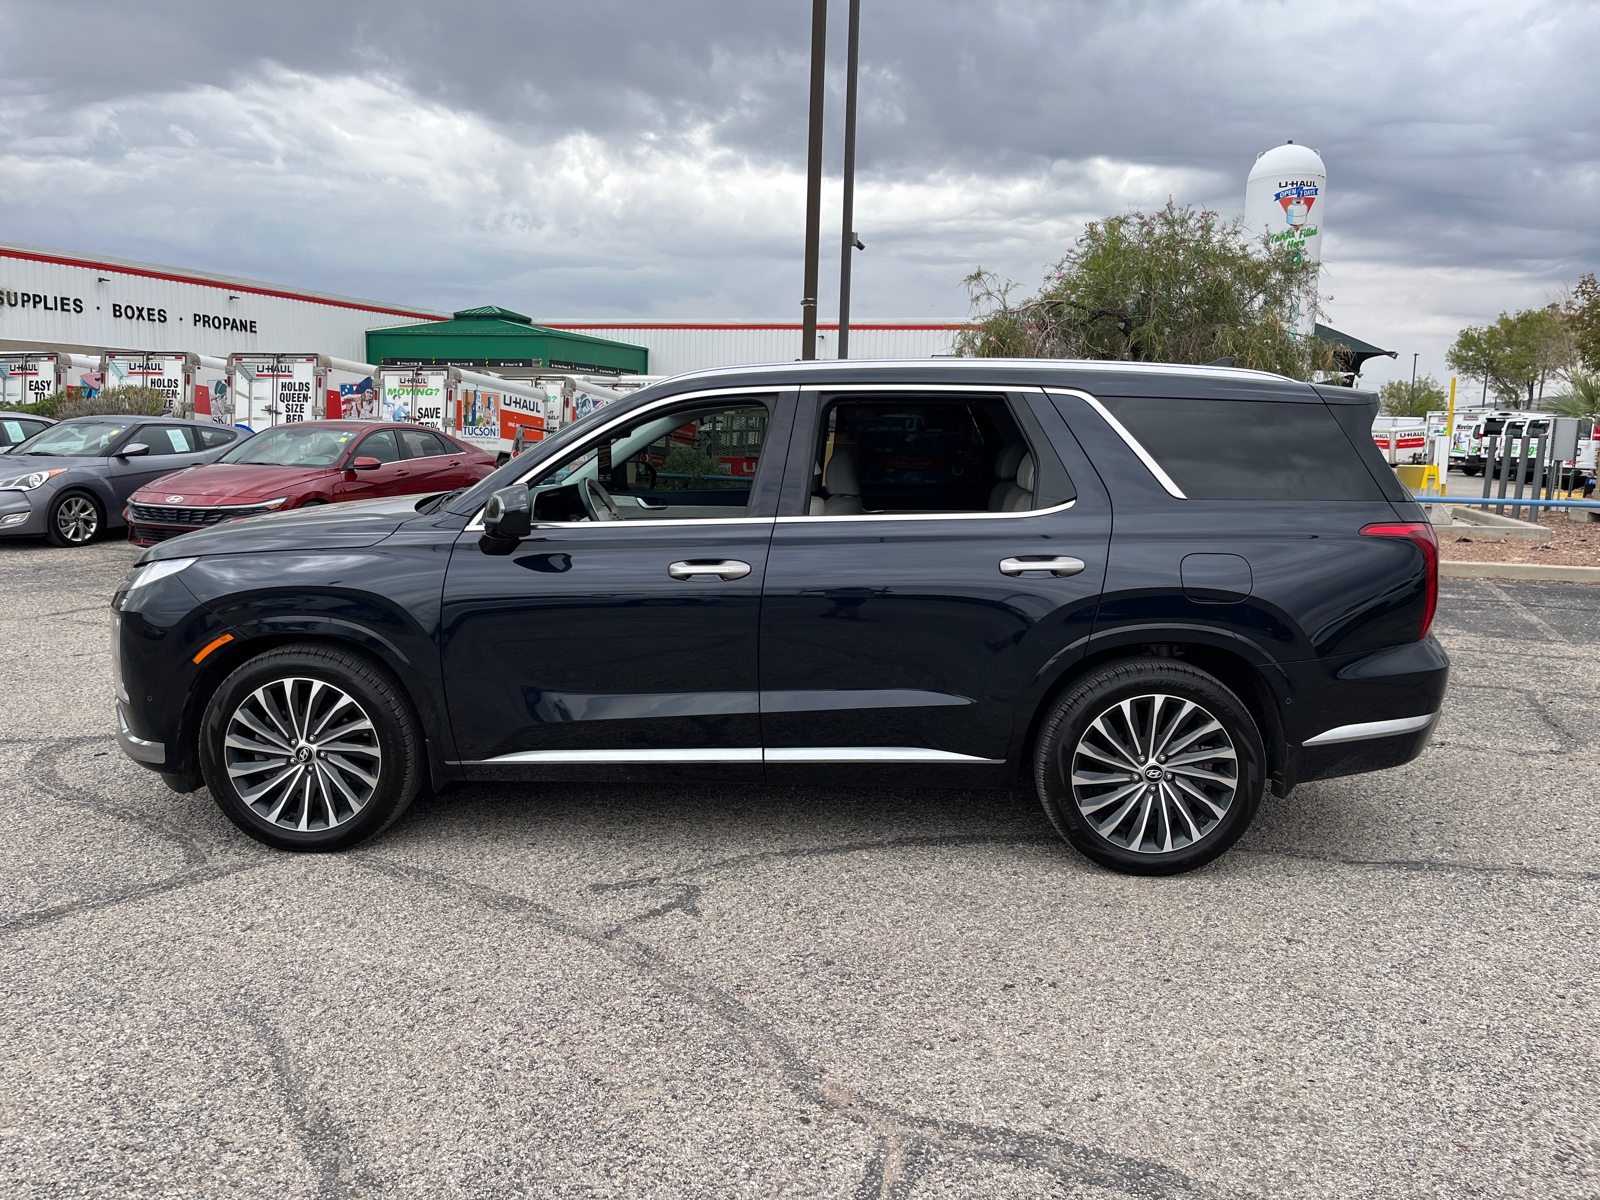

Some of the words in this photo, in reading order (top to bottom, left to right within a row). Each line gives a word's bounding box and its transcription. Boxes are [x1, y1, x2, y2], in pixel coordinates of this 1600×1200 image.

[1278, 180, 1317, 188] U-HAUL
[1280, 189, 1297, 199] OPEN
[1299, 225, 1318, 239] Filled
[1287, 239, 1305, 250] Here
[112, 303, 168, 323] BOXES
[193, 312, 258, 334] PROPANE
[29, 380, 52, 391] EASY
[150, 378, 179, 388] HOLDS
[281, 382, 310, 392] HOLDS
[279, 392, 312, 403] QUEEN-
[285, 403, 305, 414] SIZE
[503, 394, 541, 413] U-HAUL
[417, 407, 441, 419] SAVE
[463, 426, 496, 437] TUCSON
